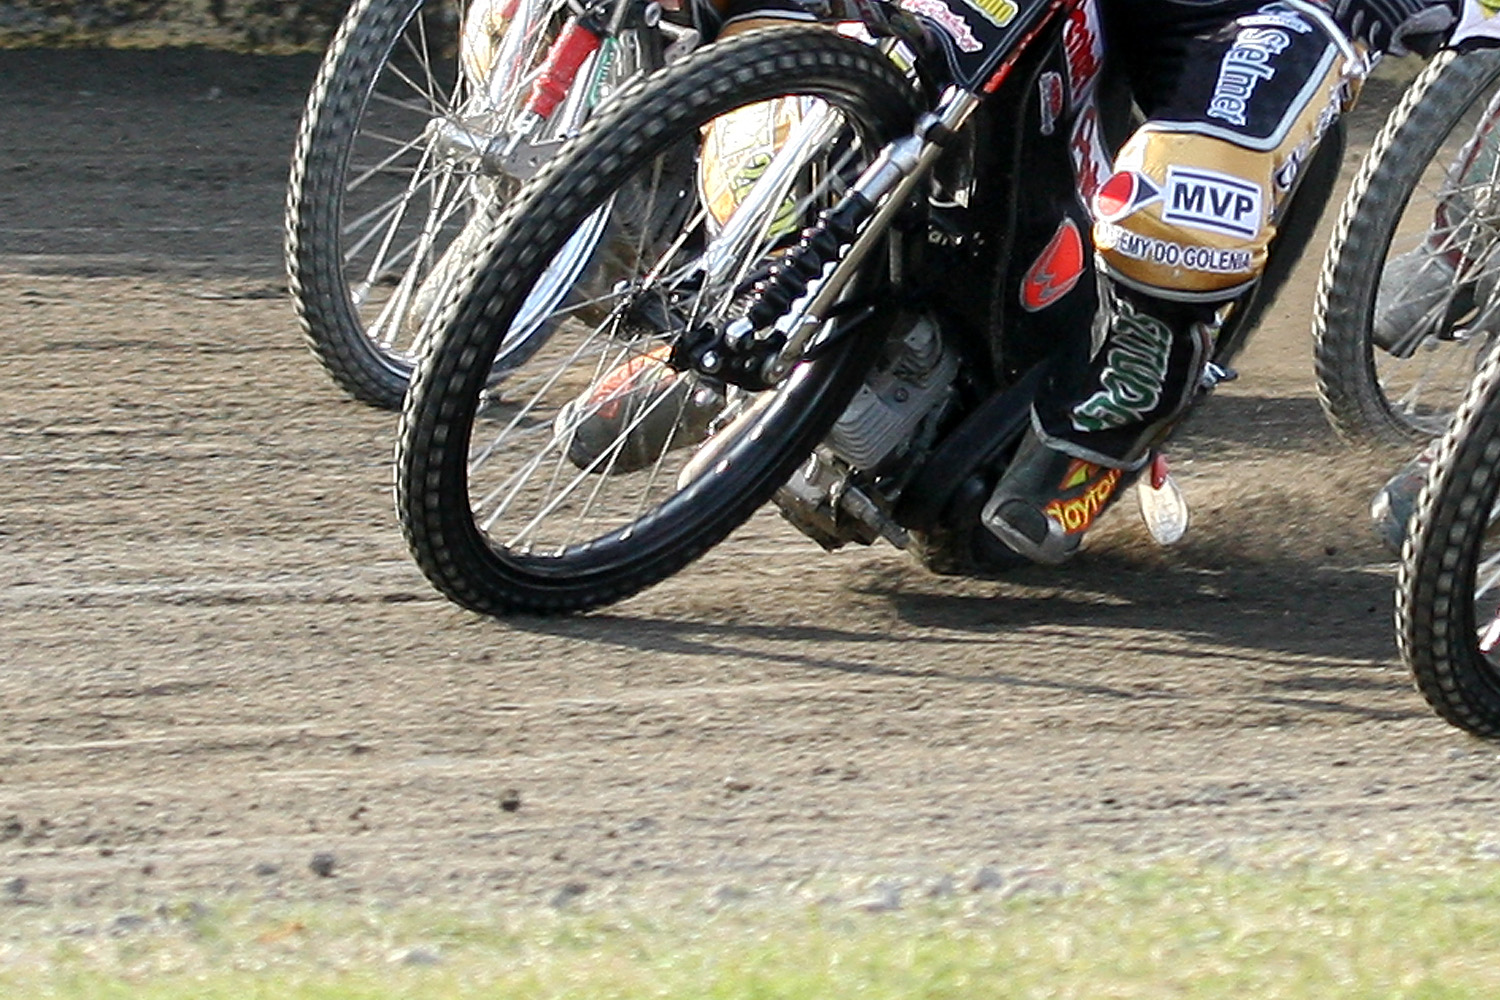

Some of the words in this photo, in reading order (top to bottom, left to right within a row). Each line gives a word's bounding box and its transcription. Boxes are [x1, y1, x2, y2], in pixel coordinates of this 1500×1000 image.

[1173, 181, 1254, 222] MVP
[1154, 242, 1180, 266] DO
[1183, 248, 1252, 272] GOLENIA
